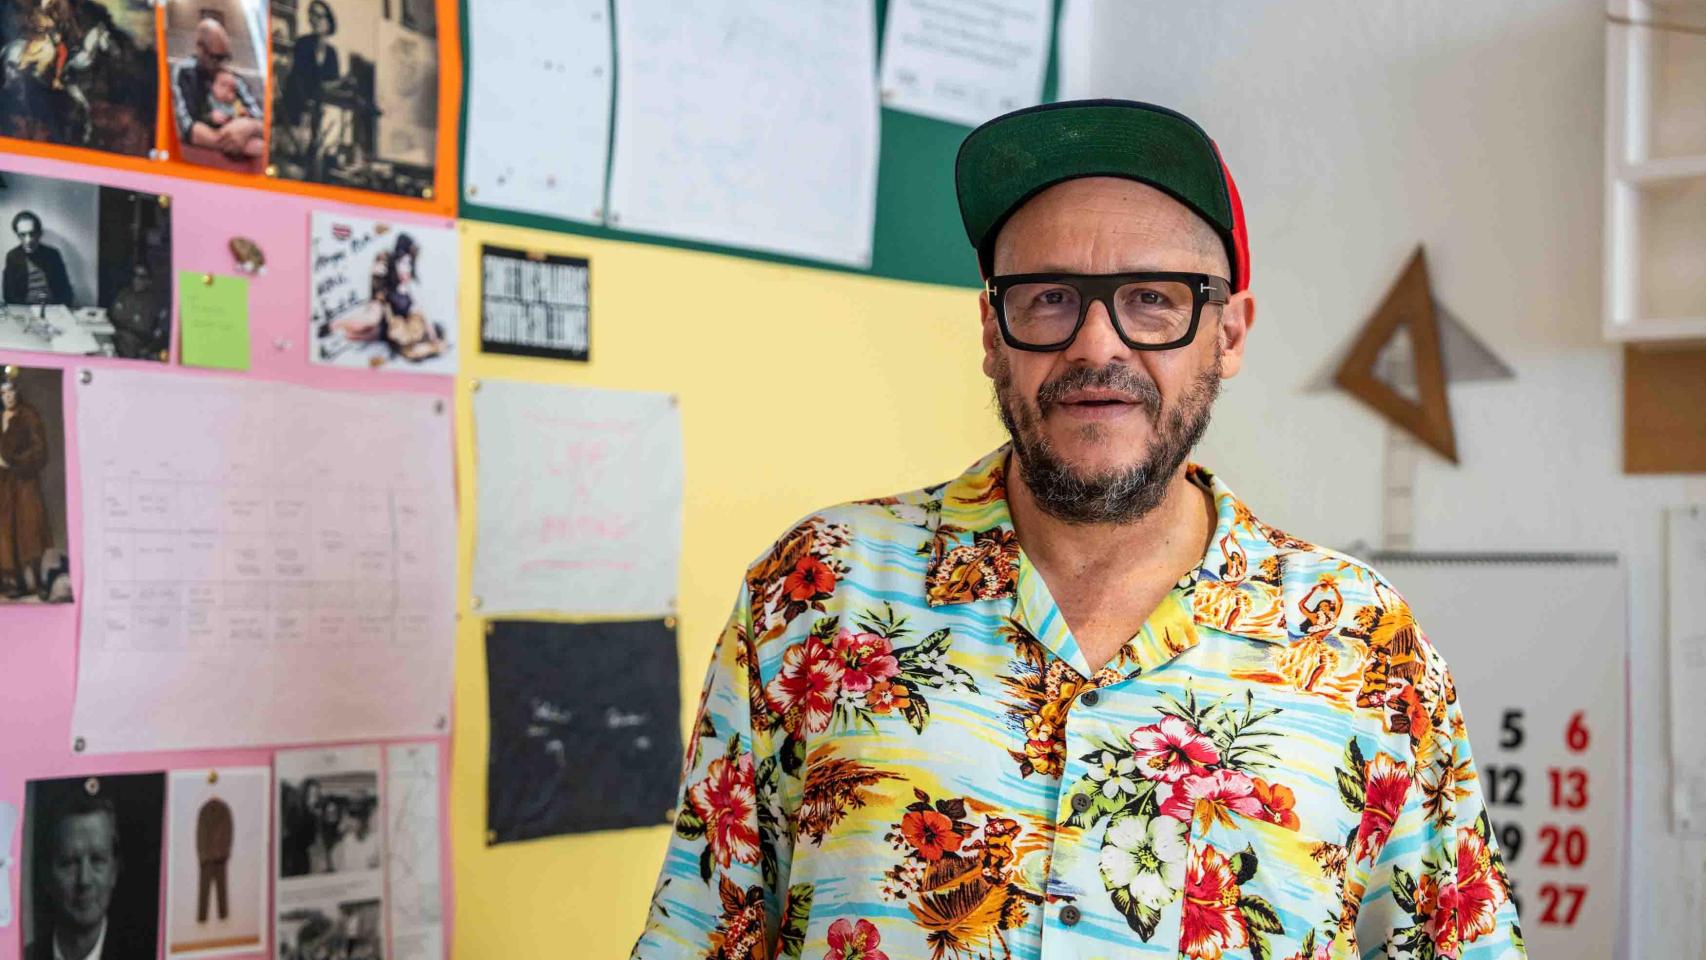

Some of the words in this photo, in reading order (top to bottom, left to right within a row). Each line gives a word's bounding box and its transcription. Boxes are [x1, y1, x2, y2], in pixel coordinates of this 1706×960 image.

[1500, 709, 1525, 750] 5
[1564, 709, 1591, 753] 6
[1485, 766, 1525, 806] 12
[1547, 767, 1590, 810] 13
[1538, 824, 1589, 869] 20
[1538, 882, 1589, 927] 27
